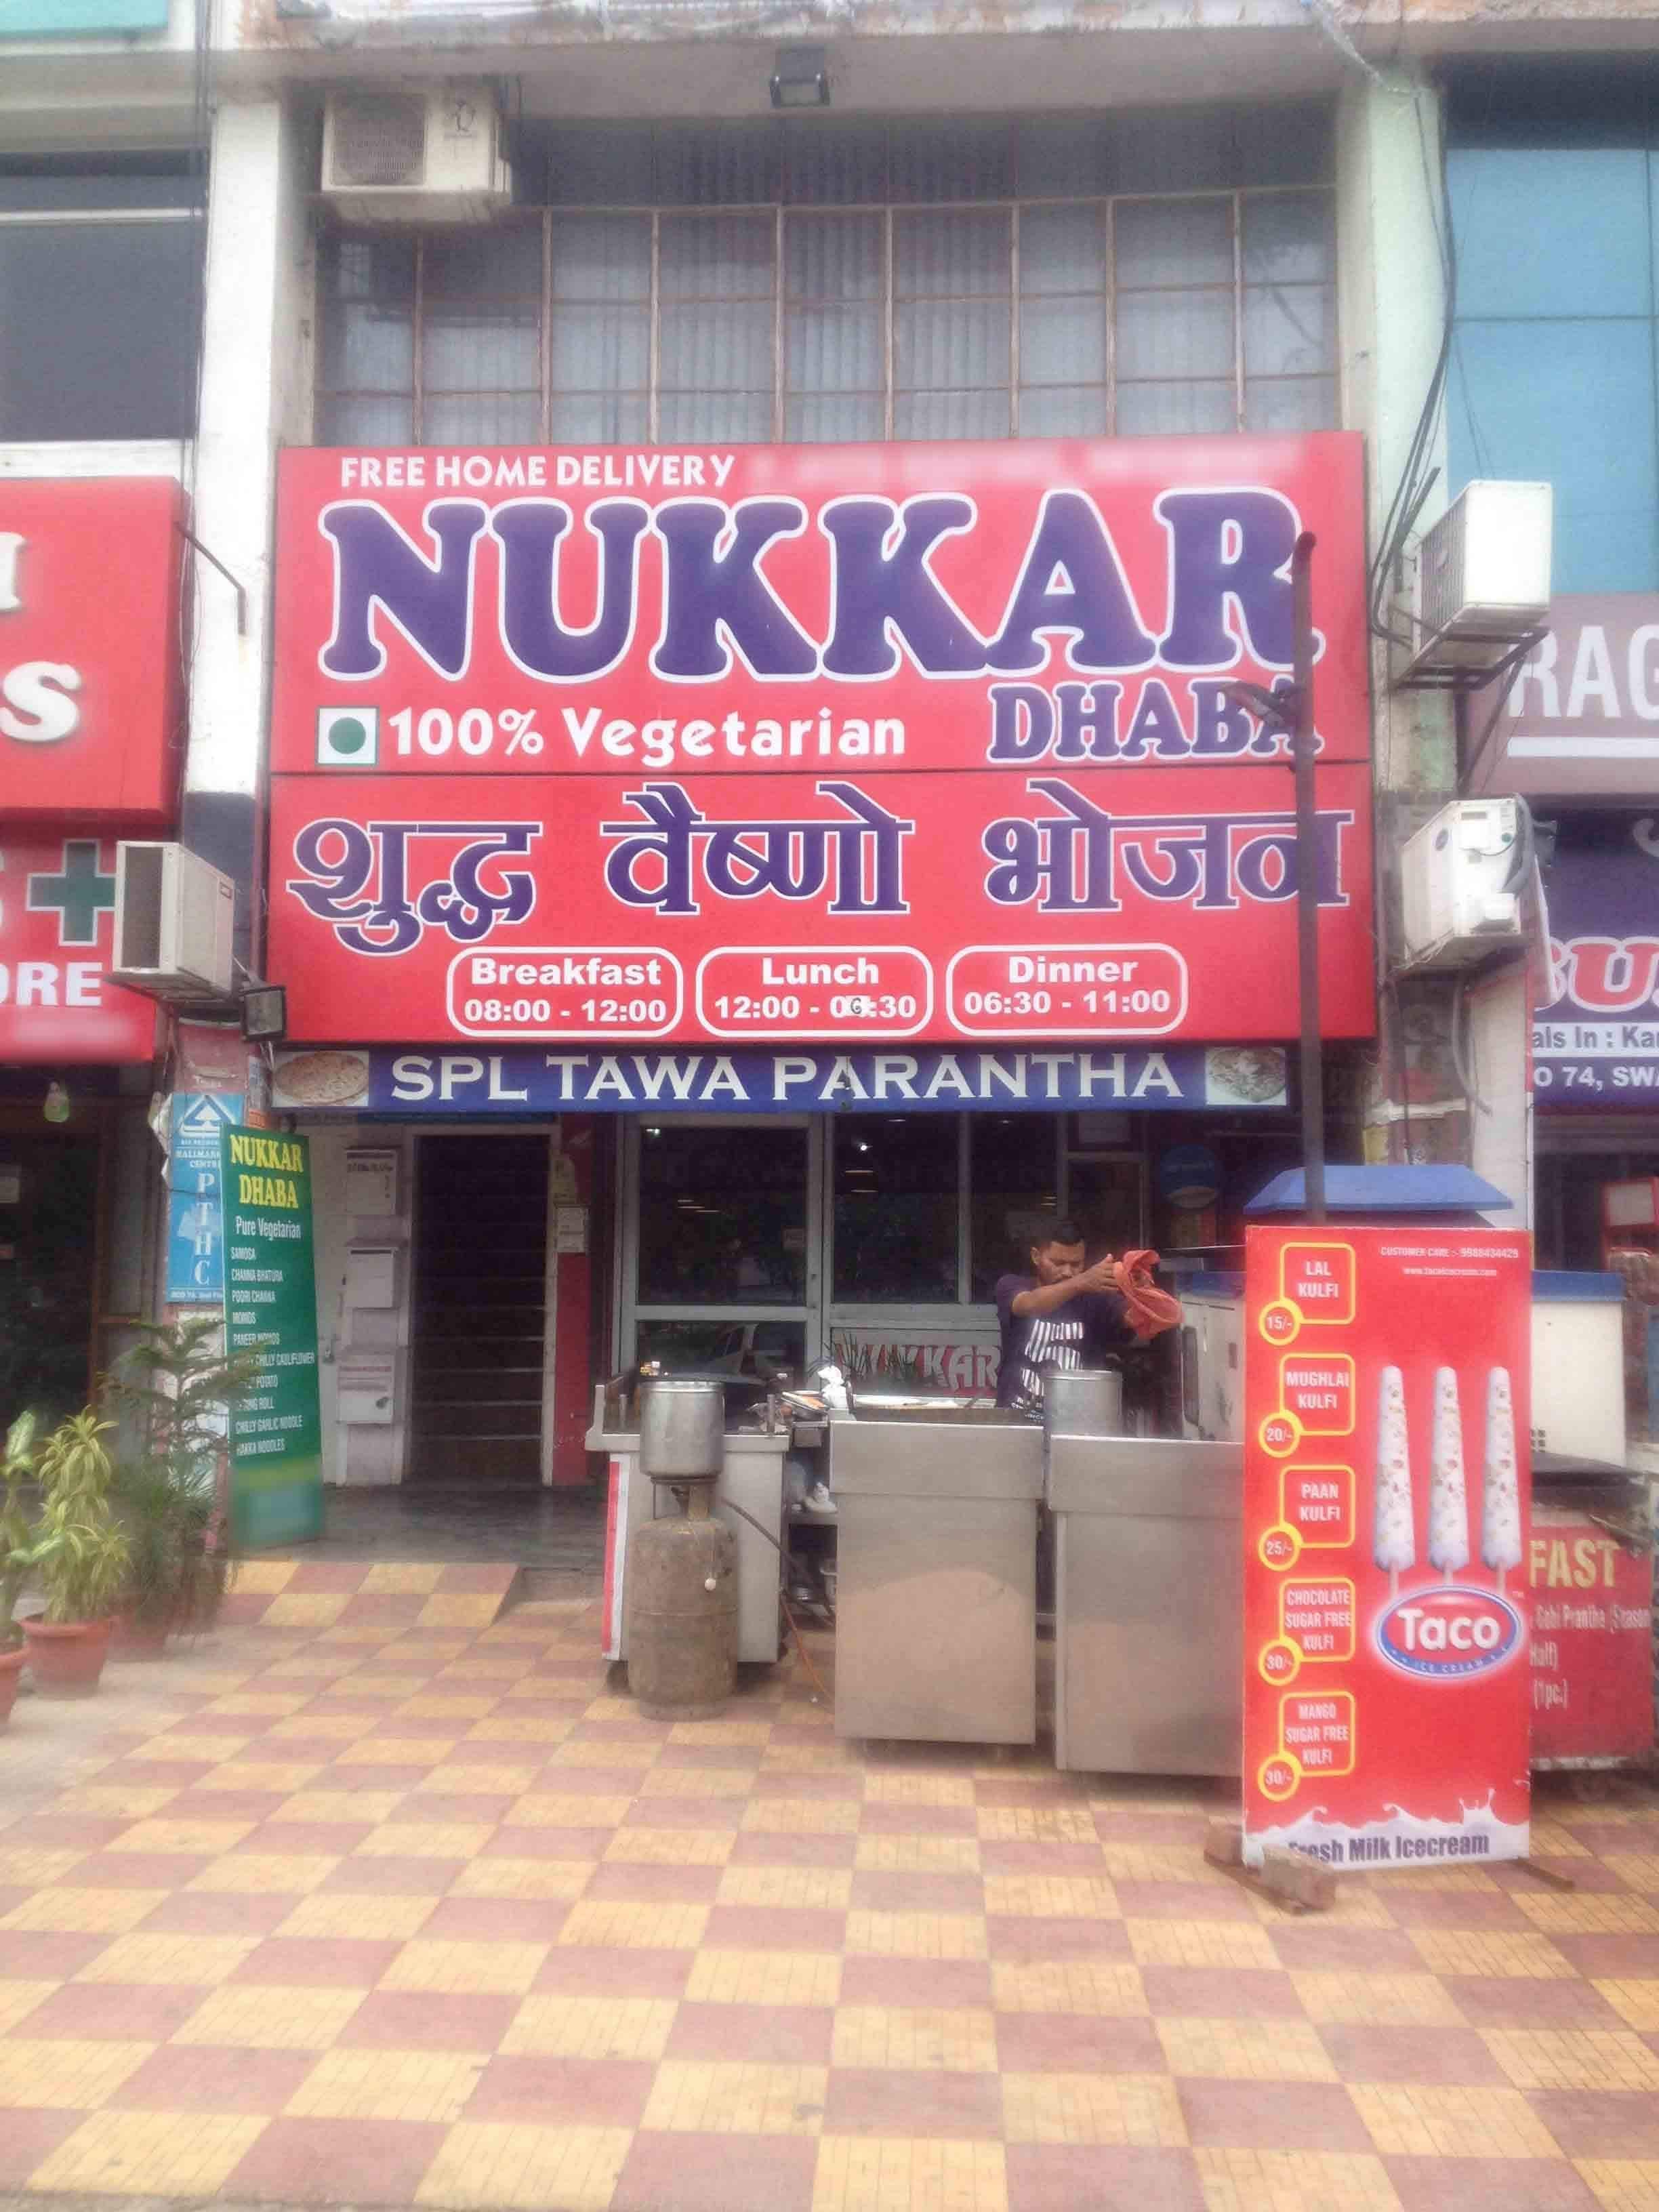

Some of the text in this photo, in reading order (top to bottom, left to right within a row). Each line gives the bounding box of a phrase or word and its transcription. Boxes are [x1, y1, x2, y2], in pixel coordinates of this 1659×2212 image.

[341, 453, 735, 488] FREE HOME DELIVERY
[316, 487, 1326, 684] NUKKAR
[987, 674, 1325, 764] DHABA
[388, 708, 906, 768] 100% Vegetarian
[286, 817, 543, 957] शुद्ध
[471, 958, 661, 986] Breakfast
[762, 958, 879, 985] Lunch
[1008, 956, 1139, 985] Dinner
[464, 999, 550, 1023] 08:00
[581, 998, 667, 1023] 12:00
[715, 995, 800, 1019] 12:00
[964, 991, 1051, 1015] 06:30
[1082, 989, 1171, 1015] 11:00
[1575, 1026, 1597, 1048] In
[391, 1052, 1185, 1102] SPL TAWA PARANTHA
[1562, 1066, 1605, 1091] 74,
[230, 1133, 304, 1173] NUKKAR
[239, 1174, 299, 1208] DHABA
[235, 1215, 302, 1241] Pure Vegetarian
[1305, 1261, 1332, 1277] LAL
[1297, 1282, 1340, 1298] KULFI
[1267, 1315, 1293, 1330] 15/-
[1286, 1371, 1351, 1388] MUGHLAI
[1297, 1393, 1338, 1410] KULFI
[1266, 1427, 1293, 1443] 20/-
[1300, 1482, 1340, 1500] PAAN
[1299, 1505, 1341, 1522] KULFI
[1266, 1540, 1293, 1556] 25/-
[1529, 1539, 1622, 1589] FAST
[1287, 1589, 1351, 1606] CHOCOLATE
[1285, 1610, 1352, 1629] SUGAR FREE
[1396, 1607, 1501, 1652] Taco
[1303, 1634, 1335, 1652] KULFI
[1298, 1702, 1337, 1720] MANGO
[1285, 1725, 1349, 1744] SUGAR FREE
[1302, 1748, 1332, 1766] KULFI
[1349, 1837, 1392, 1862] Milk
[1395, 1833, 1490, 1859] Icecream
